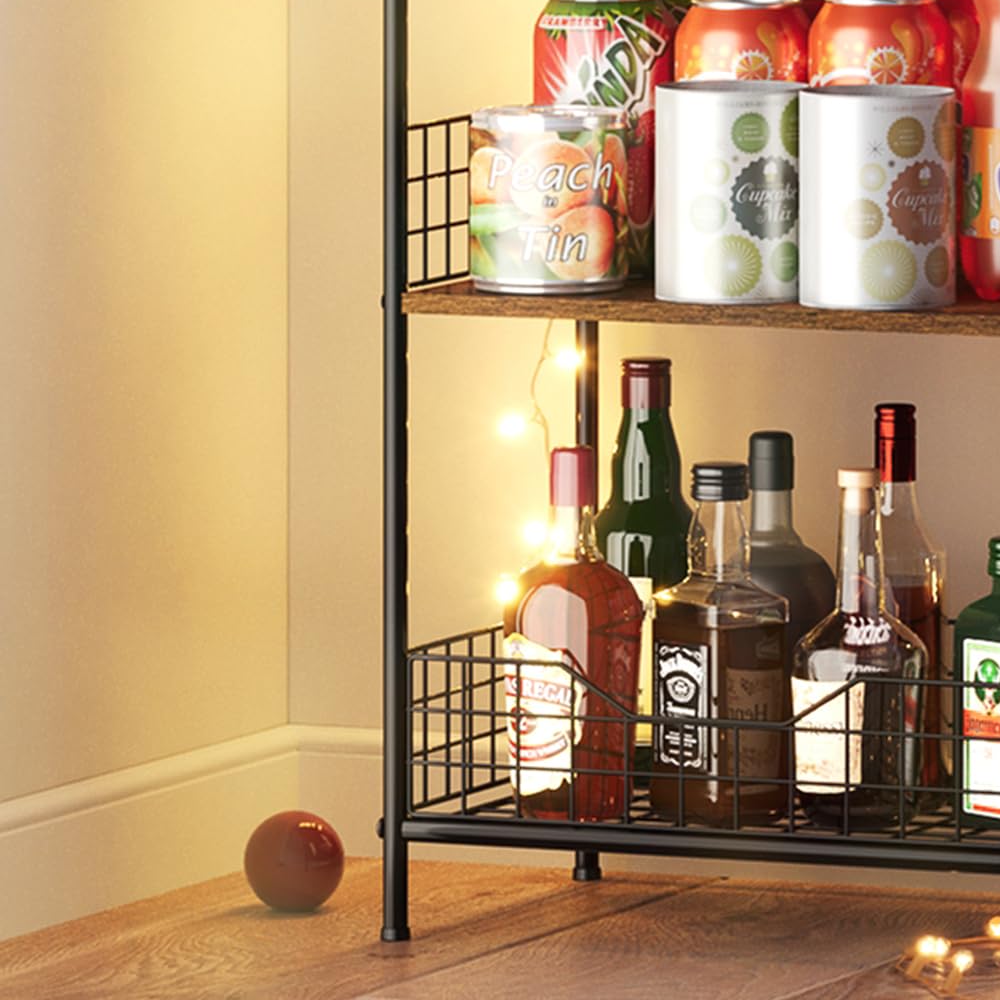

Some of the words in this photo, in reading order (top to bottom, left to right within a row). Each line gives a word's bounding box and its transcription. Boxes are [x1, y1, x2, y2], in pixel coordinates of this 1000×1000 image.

[487, 152, 613, 192] Peach
[542, 194, 559, 208] in
[517, 224, 589, 262] Tin
